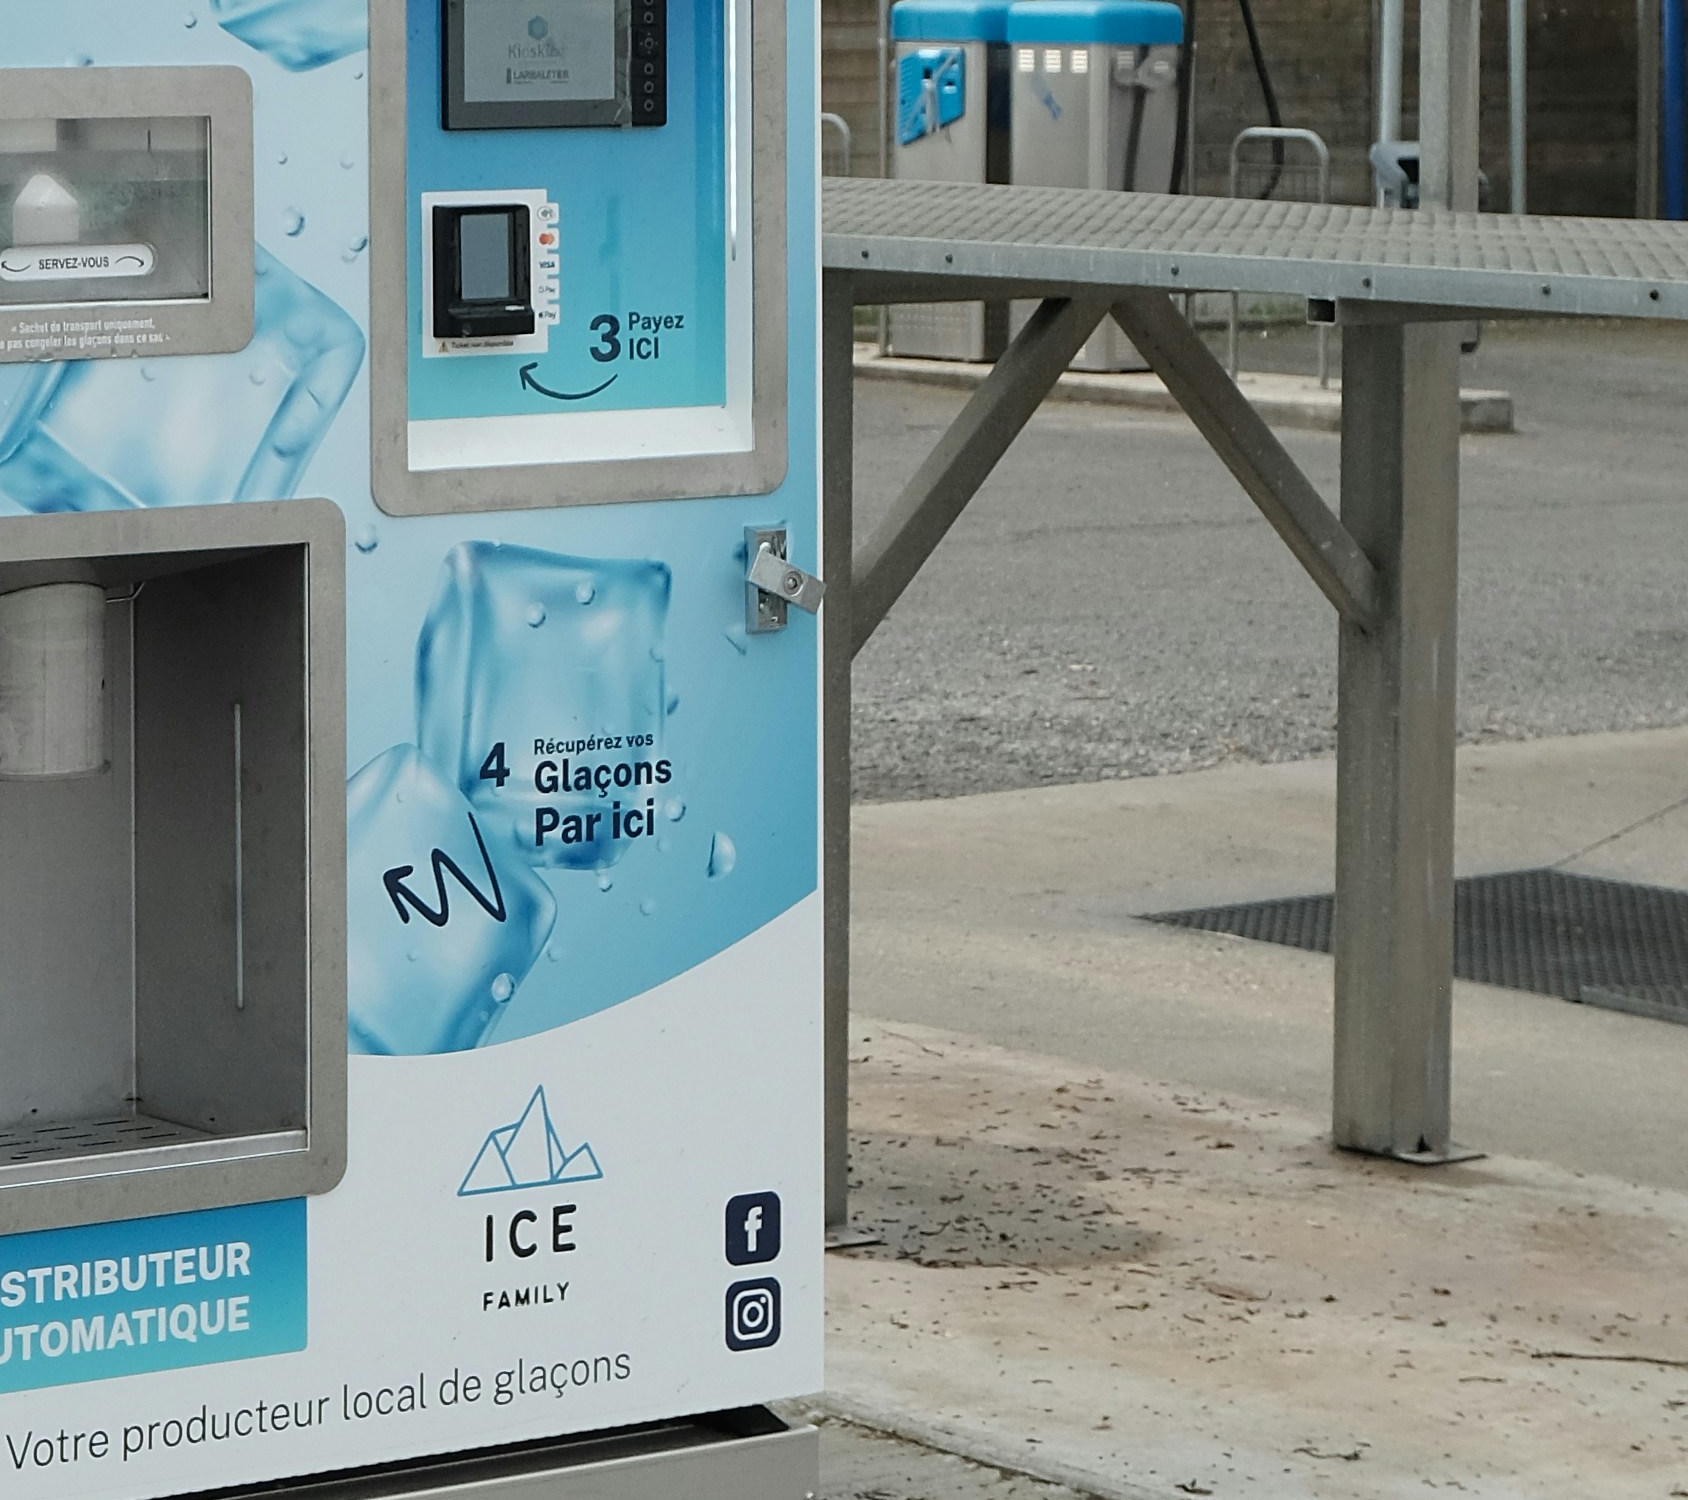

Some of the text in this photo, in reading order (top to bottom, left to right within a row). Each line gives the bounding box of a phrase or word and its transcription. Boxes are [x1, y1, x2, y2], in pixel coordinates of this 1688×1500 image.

[38, 256, 110, 270] SERVEZ-VOUS
[19, 322, 49, 334] Sachet
[50, 321, 61, 333] de
[63, 319, 102, 334] transport
[627, 312, 685, 332] Payez
[7, 338, 23, 351] pas
[24, 336, 62, 350] congeler
[64, 335, 77, 347] les
[78, 333, 112, 349] glaçons
[114, 332, 135, 344] dans
[136, 333, 147, 344] ce
[589, 314, 622, 363] 3
[628, 337, 660, 361] ICI
[533, 733, 654, 755] Récupérez vos
[479, 742, 511, 788] 4
[534, 758, 672, 798] Glaçons
[535, 797, 655, 847] Par ici
[485, 1203, 577, 1263] ICE
[482, 1281, 569, 1312] FAMILY
[6, 1352, 632, 1470] Votre producteur local de glaçons
